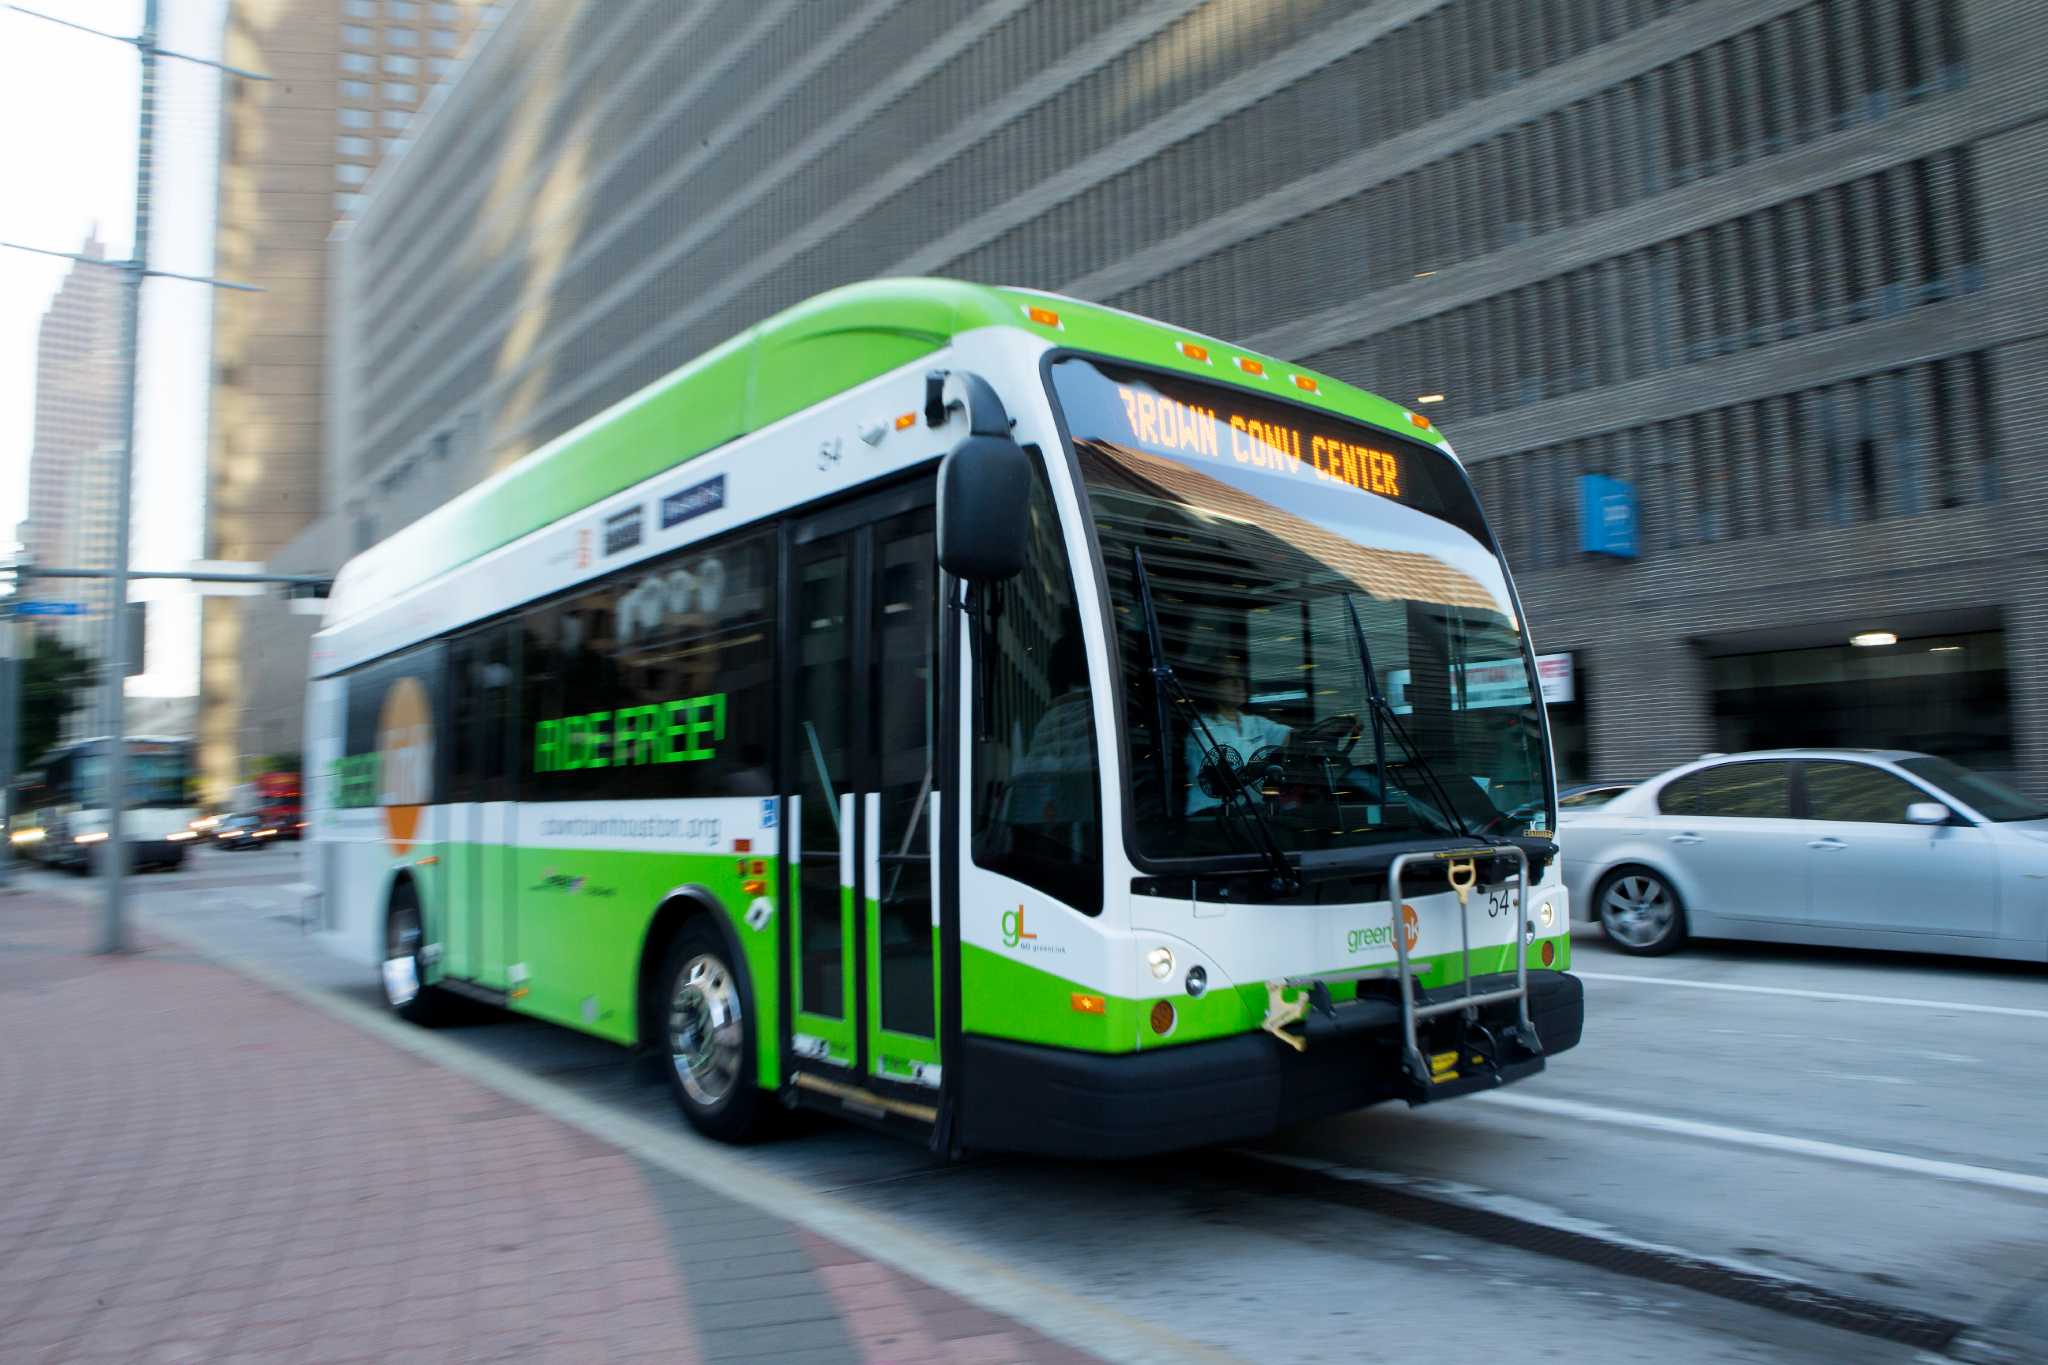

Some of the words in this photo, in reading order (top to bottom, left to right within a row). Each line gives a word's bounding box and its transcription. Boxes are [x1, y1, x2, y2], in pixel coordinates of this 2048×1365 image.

[1230, 414, 1301, 474] CONV
[1311, 434, 1400, 497] CENTER
[1488, 888, 1510, 918] 54
